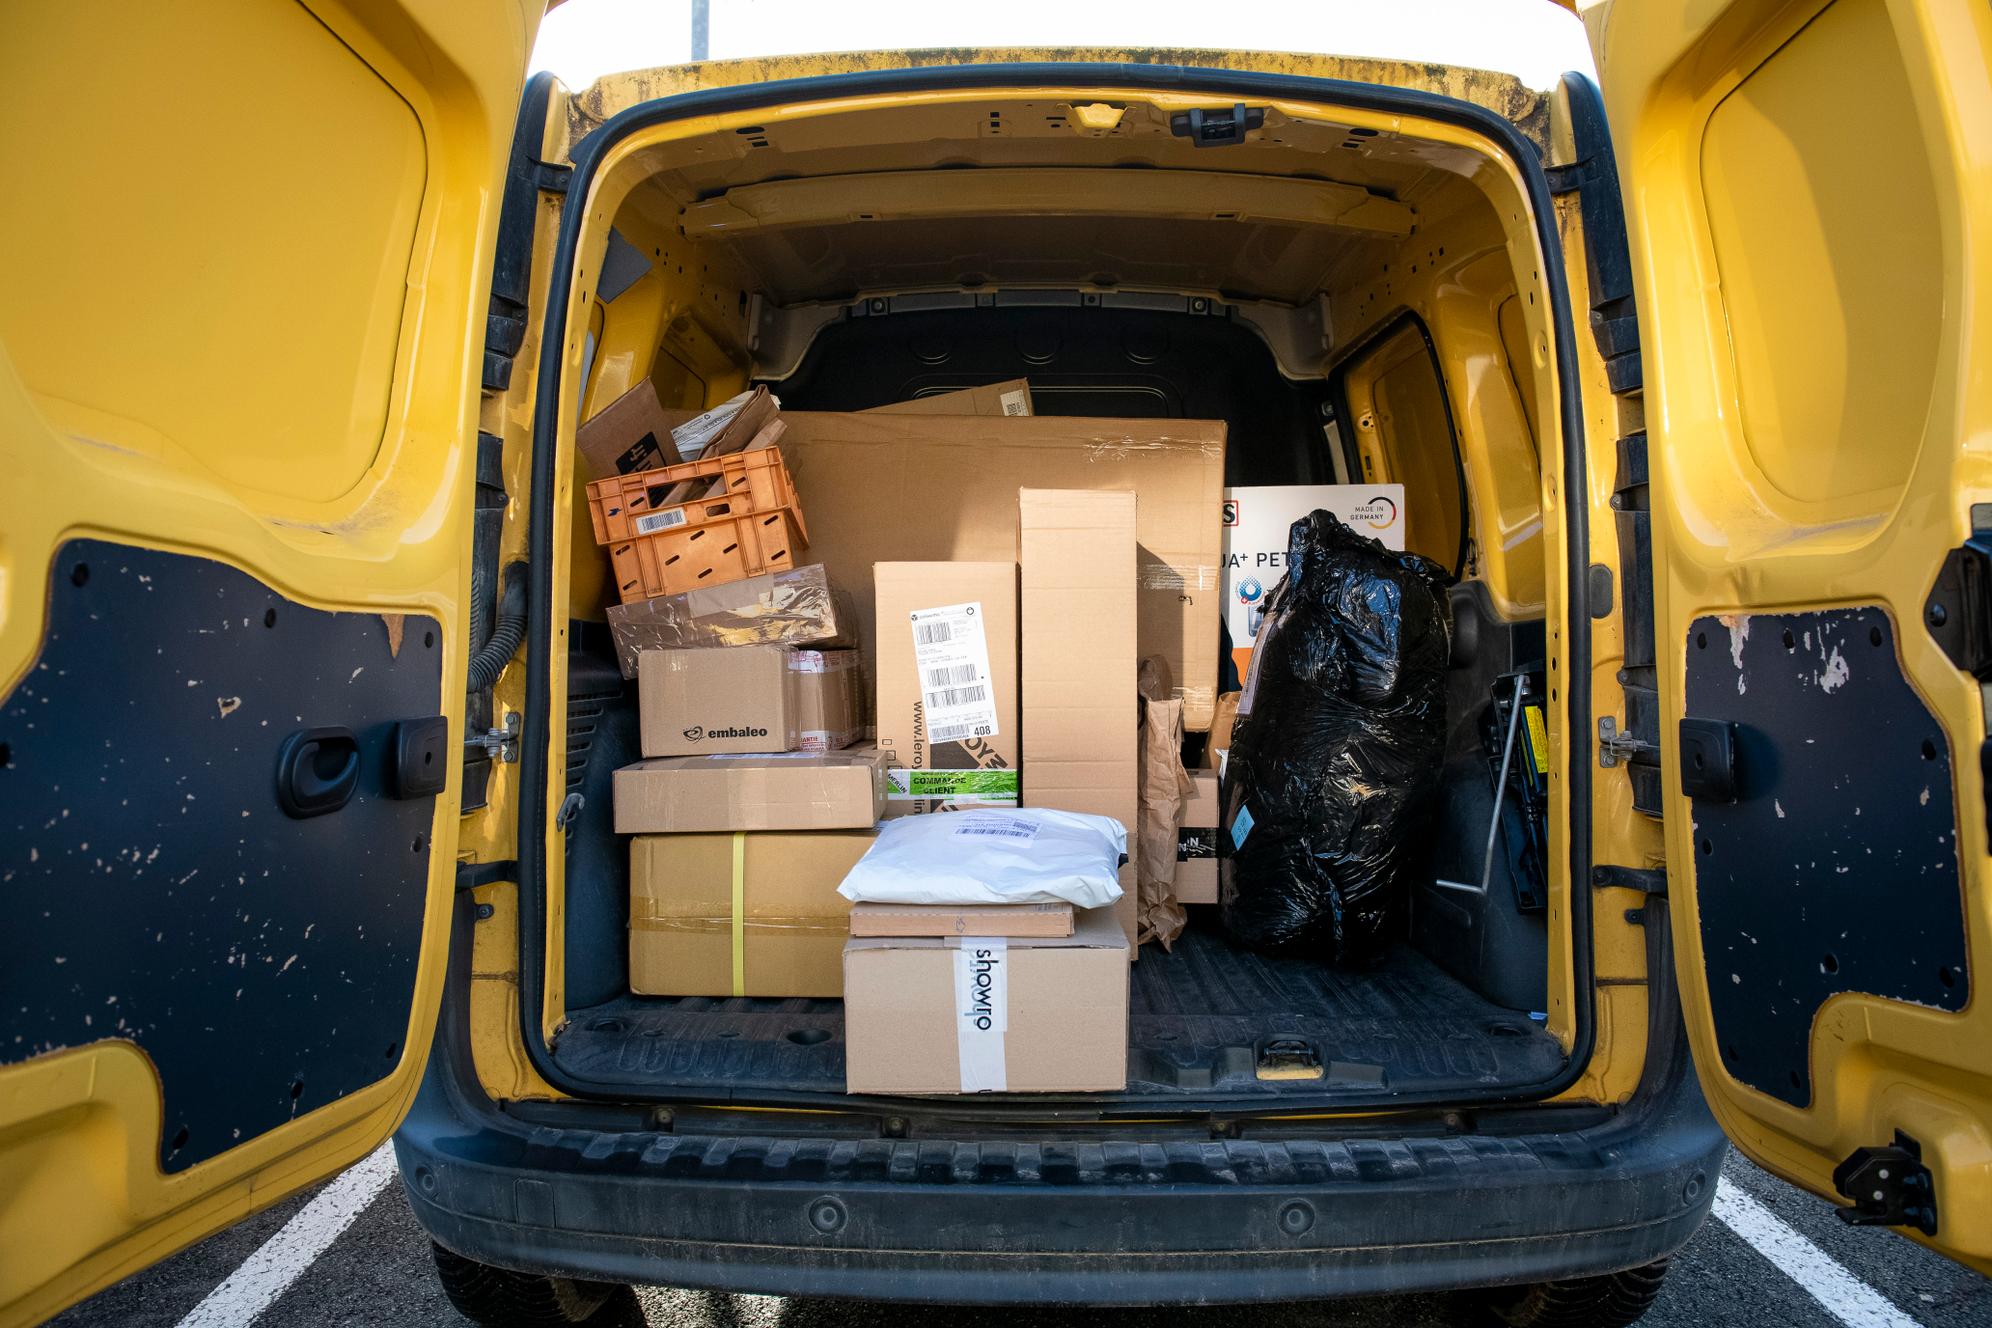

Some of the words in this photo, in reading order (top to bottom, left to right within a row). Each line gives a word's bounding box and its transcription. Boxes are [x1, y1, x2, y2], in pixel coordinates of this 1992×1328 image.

[707, 726, 768, 738] embaleo
[974, 725, 991, 737] 408
[976, 949, 999, 1031] showro
